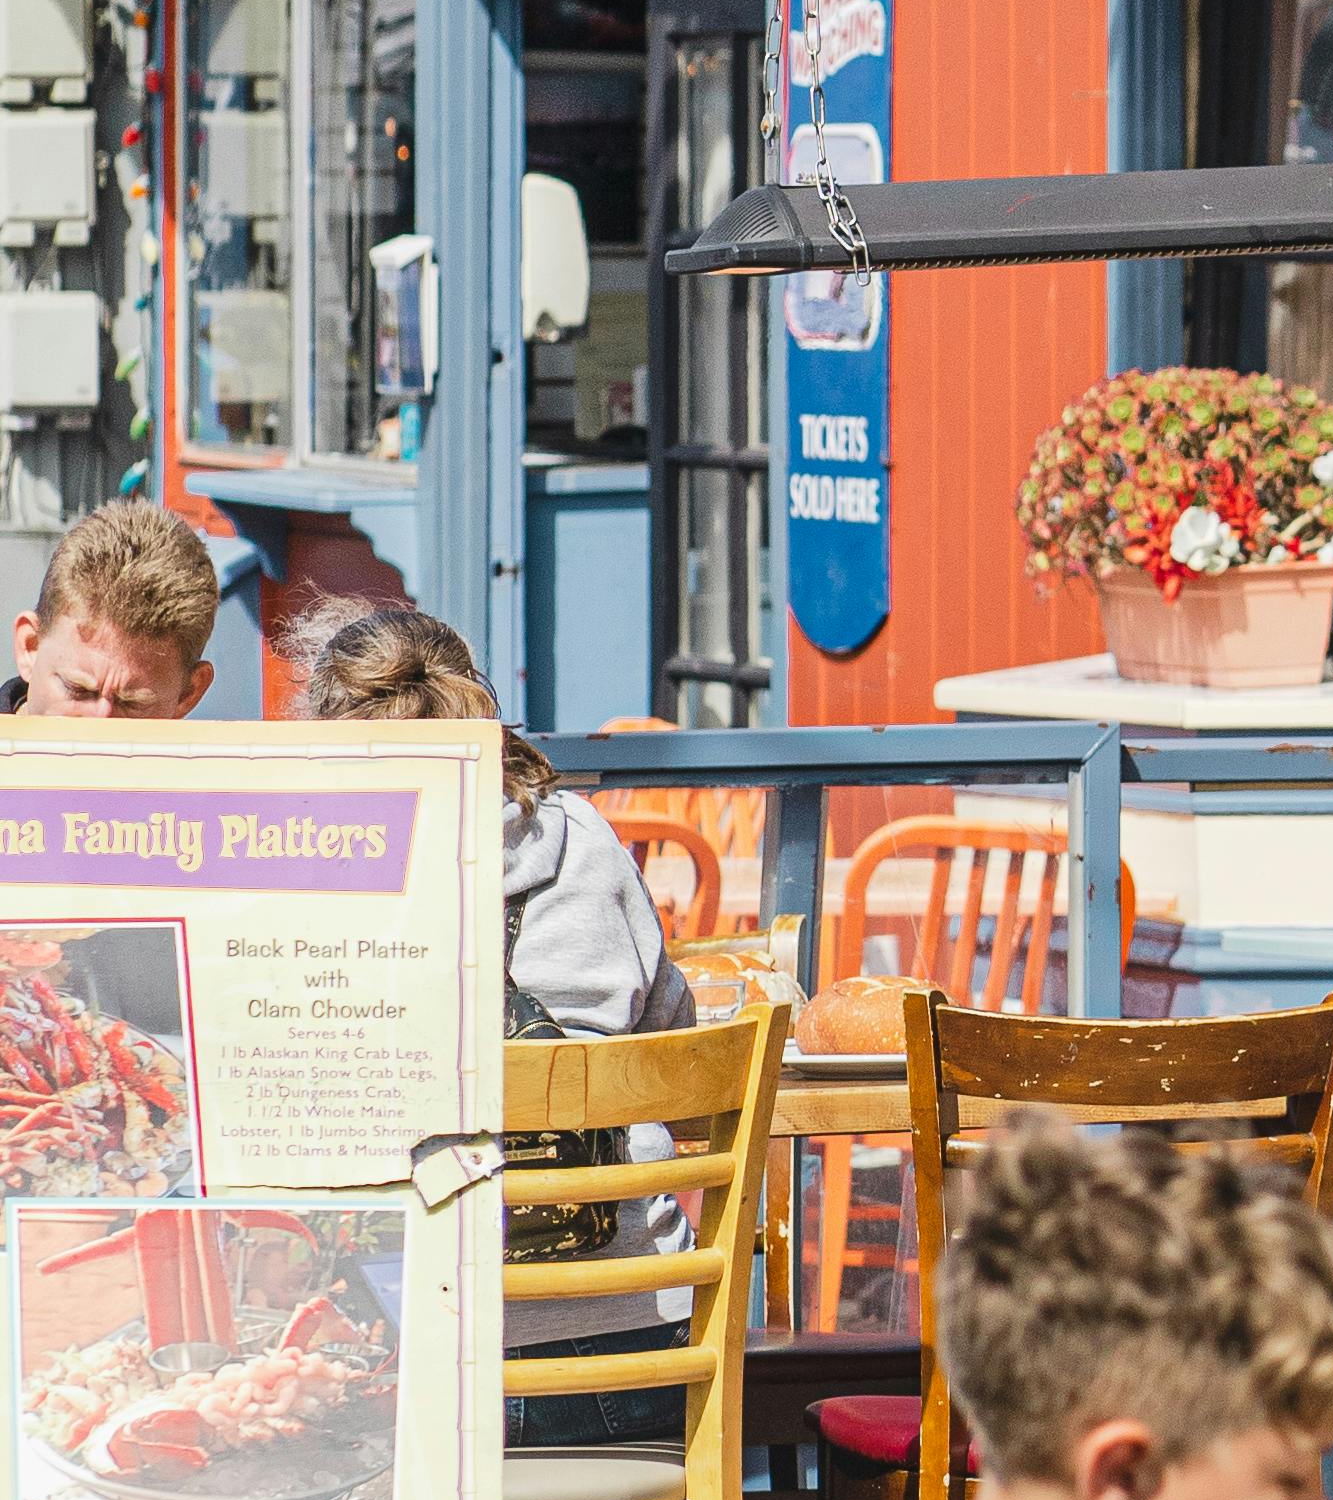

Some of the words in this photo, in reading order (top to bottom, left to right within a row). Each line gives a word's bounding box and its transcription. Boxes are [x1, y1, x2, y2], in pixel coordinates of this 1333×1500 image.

[799, 414, 869, 463] TICKETS
[789, 473, 835, 520] SOLD
[836, 475, 880, 524] HERE
[62, 811, 205, 873] Family
[218, 813, 389, 859] Platters
[226, 938, 284, 959] Black
[294, 938, 348, 959] Pearl
[358, 939, 429, 959] Platter
[304, 968, 349, 989] with
[248, 998, 301, 1019] Clam
[311, 998, 407, 1020] Chowder
[288, 1027, 336, 1040] Serves
[342, 1027, 365, 1040] 4-6
[234, 1046, 247, 1060] lb
[252, 1046, 309, 1060] Alaskan
[315, 1046, 348, 1063] King
[354, 1046, 390, 1060] Crab
[230, 1066, 242, 1079] lb
[248, 1066, 305, 1080] Alaskan
[312, 1066, 351, 1080] Snow
[357, 1066, 393, 1080] Crab
[247, 1086, 254, 1098] 2
[260, 1086, 273, 1098] lb
[279, 1085, 359, 1102] Dungeness
[288, 1105, 301, 1118] lb
[306, 1105, 355, 1118] Whole
[361, 1105, 406, 1118] Maine
[221, 1125, 282, 1139] Lobster,
[301, 1125, 314, 1138] lb
[318, 1125, 367, 1140] Jumbo
[240, 1145, 261, 1157] 1/2
[267, 1145, 280, 1157] lb
[286, 1145, 331, 1157] Clams
[338, 1145, 348, 1157] &
[354, 1144, 411, 1157] Mussels
